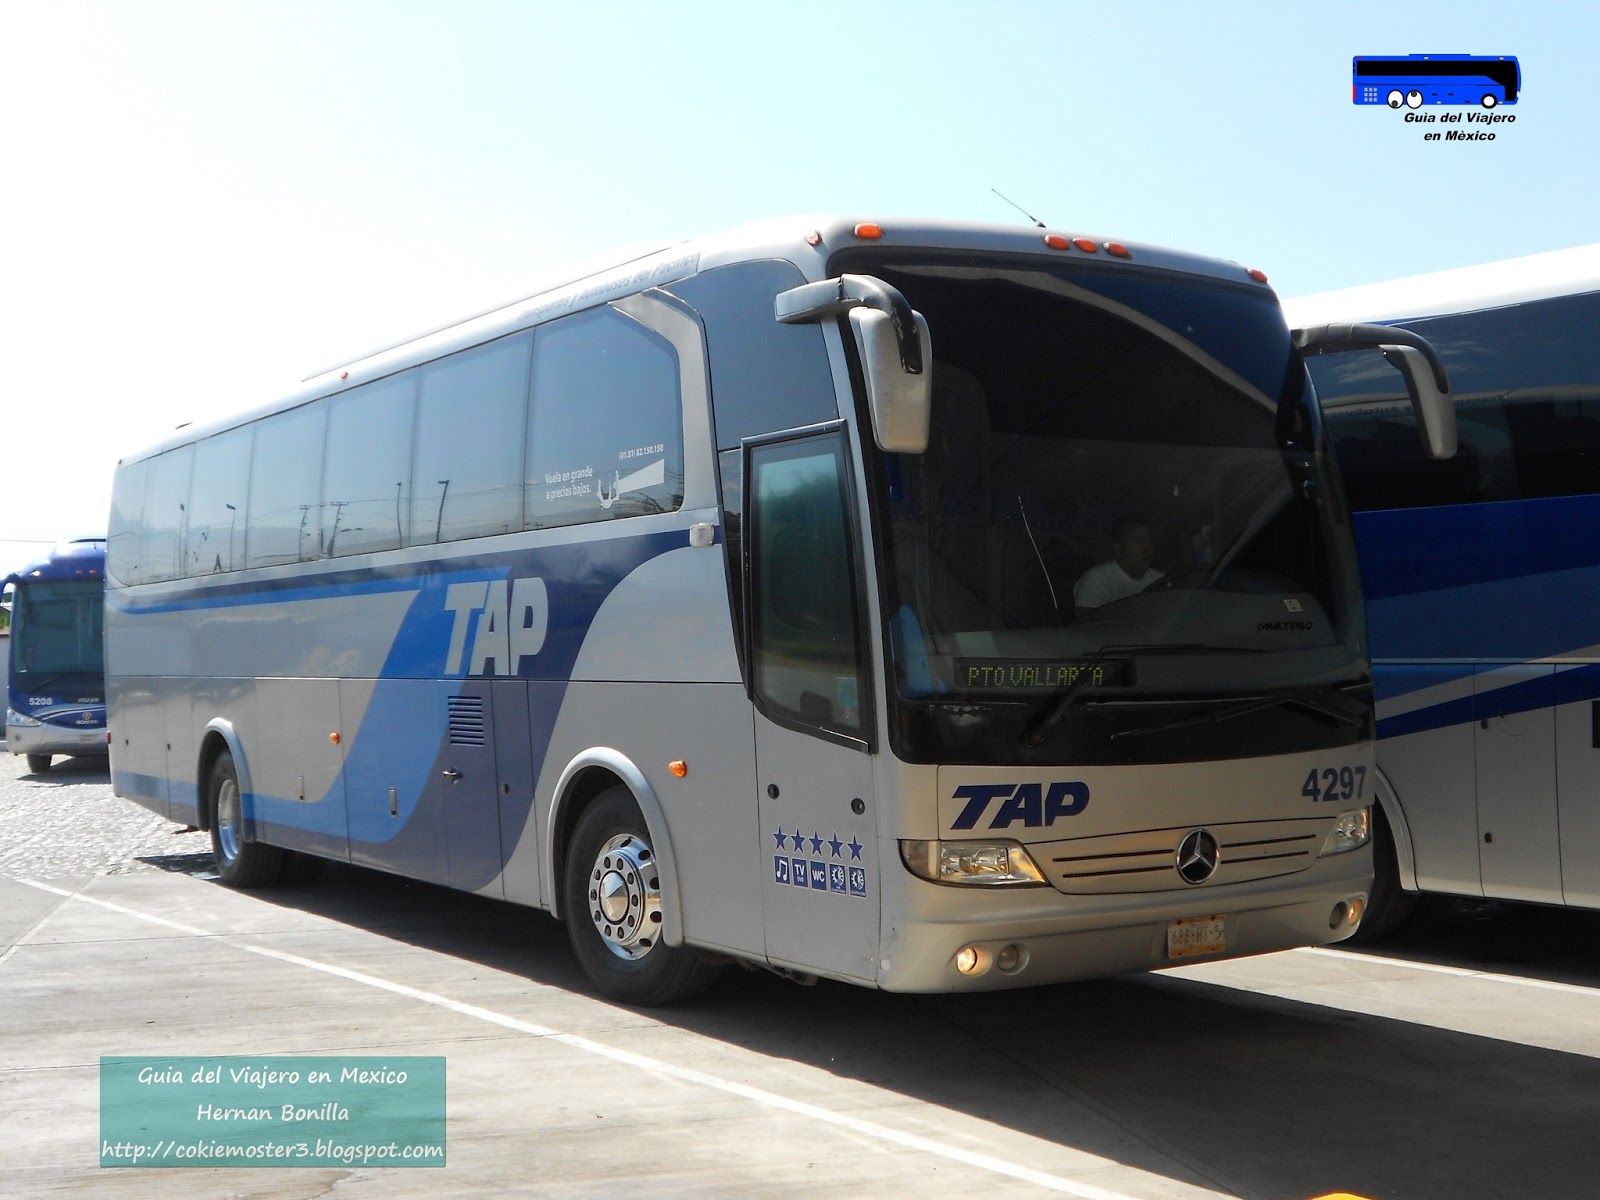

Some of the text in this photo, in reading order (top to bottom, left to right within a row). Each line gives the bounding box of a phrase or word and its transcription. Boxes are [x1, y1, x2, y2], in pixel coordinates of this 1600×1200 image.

[545, 465, 593, 485] Vuela en grande
[550, 485, 572, 502] precios
[444, 577, 548, 676] TAP
[968, 667, 1005, 686] PTO
[28, 697, 53, 706] 5208
[1301, 765, 1367, 802] 4297
[950, 781, 1090, 830] TAP
[794, 863, 805, 876] TV
[812, 869, 825, 882] WC
